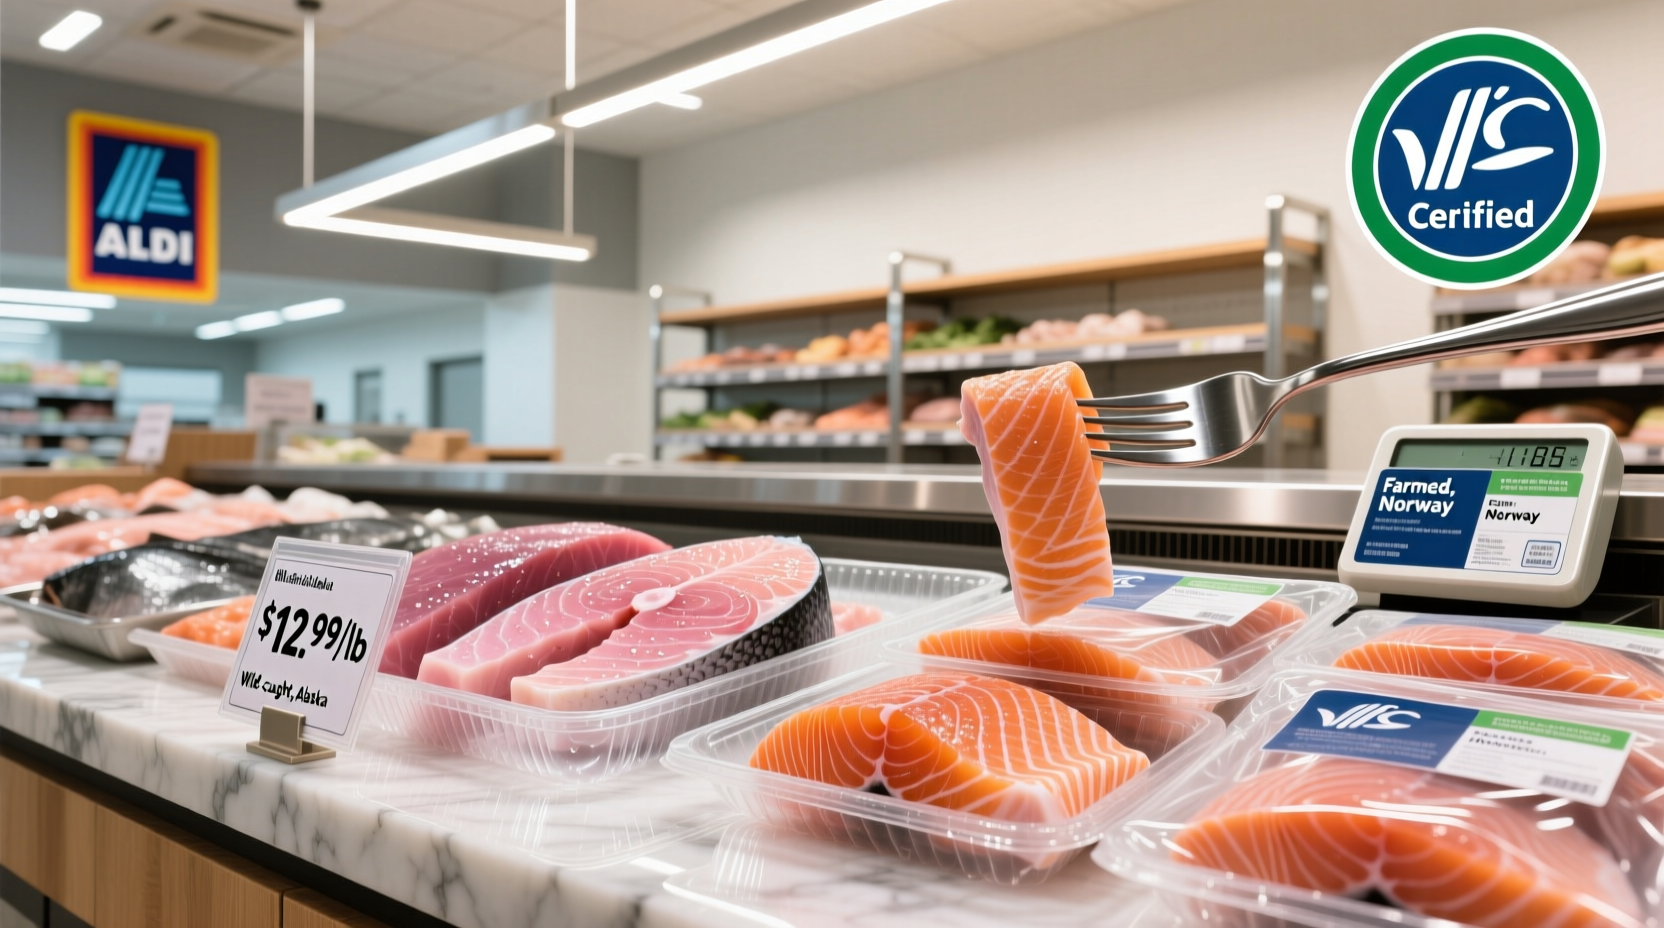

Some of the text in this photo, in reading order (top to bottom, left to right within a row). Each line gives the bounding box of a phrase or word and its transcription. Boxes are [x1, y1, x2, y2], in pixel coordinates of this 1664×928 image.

[94, 221, 195, 267] ALDI
[1382, 476, 1456, 497] Farmed,
[1378, 495, 1454, 518] Norway
[1485, 508, 1541, 525] Norway
[258, 599, 368, 664] $12.99/lb
